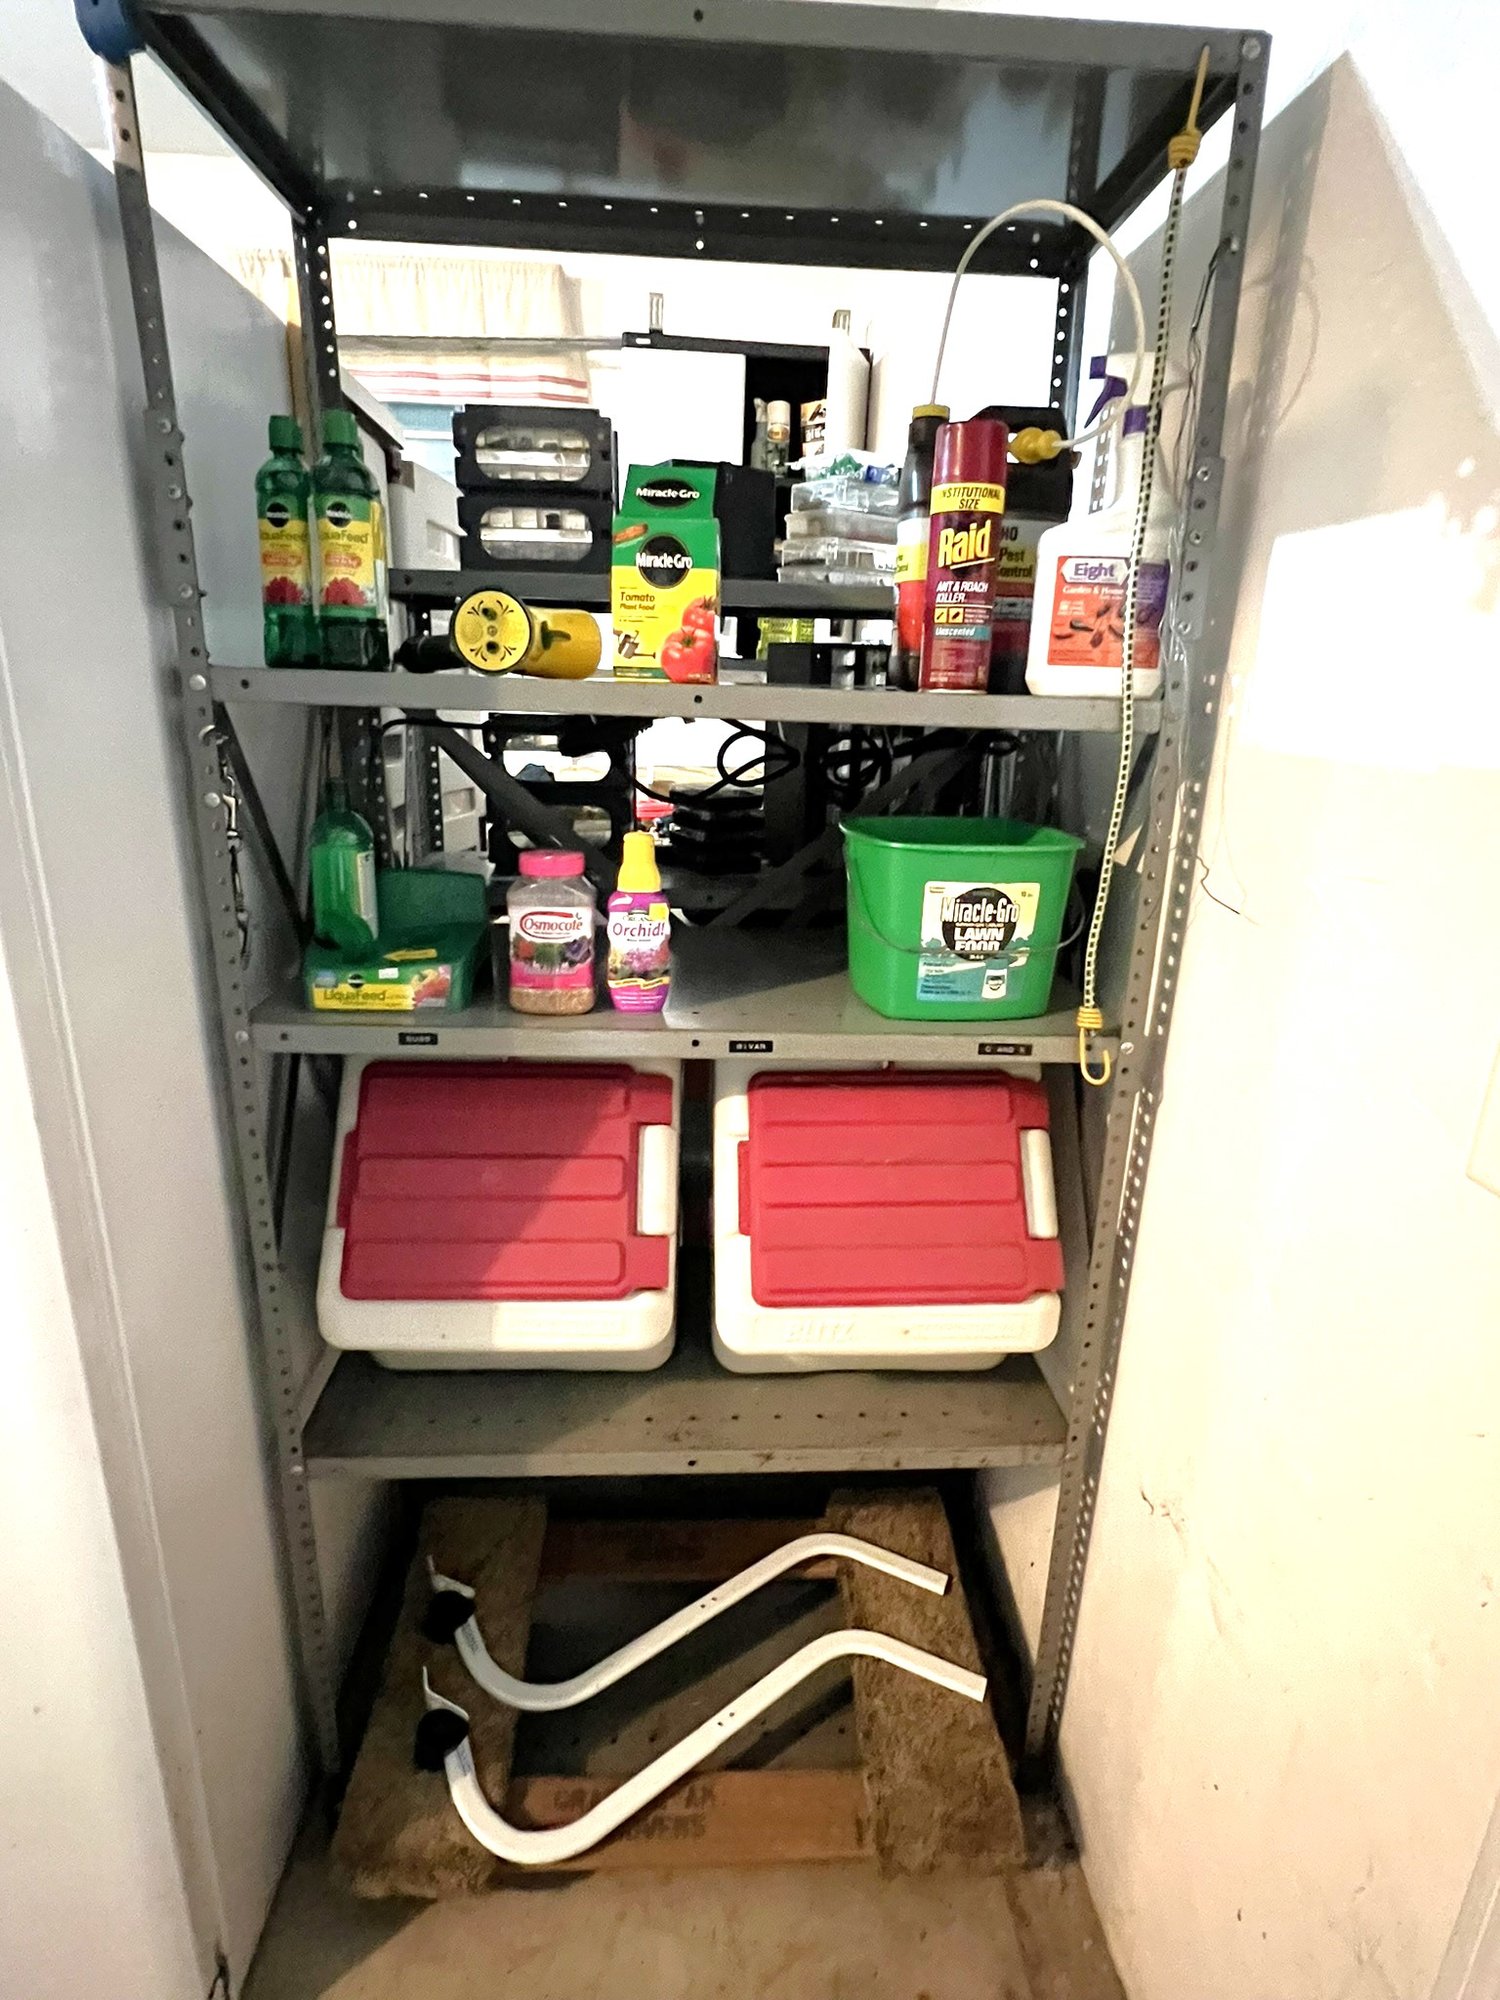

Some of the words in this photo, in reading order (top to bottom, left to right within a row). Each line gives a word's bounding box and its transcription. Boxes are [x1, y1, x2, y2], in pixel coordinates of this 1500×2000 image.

[958, 498, 981, 510] SIZE
[937, 518, 992, 569] Raid
[1000, 547, 1025, 561] Pest
[999, 564, 1033, 578] ontrol
[1073, 562, 1116, 580] Eight
[935, 580, 954, 592] ANT
[960, 581, 989, 593] ROACH
[1062, 585, 1092, 595] Garden
[620, 591, 656, 602] Tomato
[935, 592, 966, 604] KILLER
[638, 603, 656, 611] Food
[935, 626, 976, 637] Unscented
[940, 896, 1021, 923] Miracle-Gro
[522, 917, 584, 932] Osmocote
[612, 922, 665, 937] Orchid!
[953, 927, 1005, 941] LAWN
